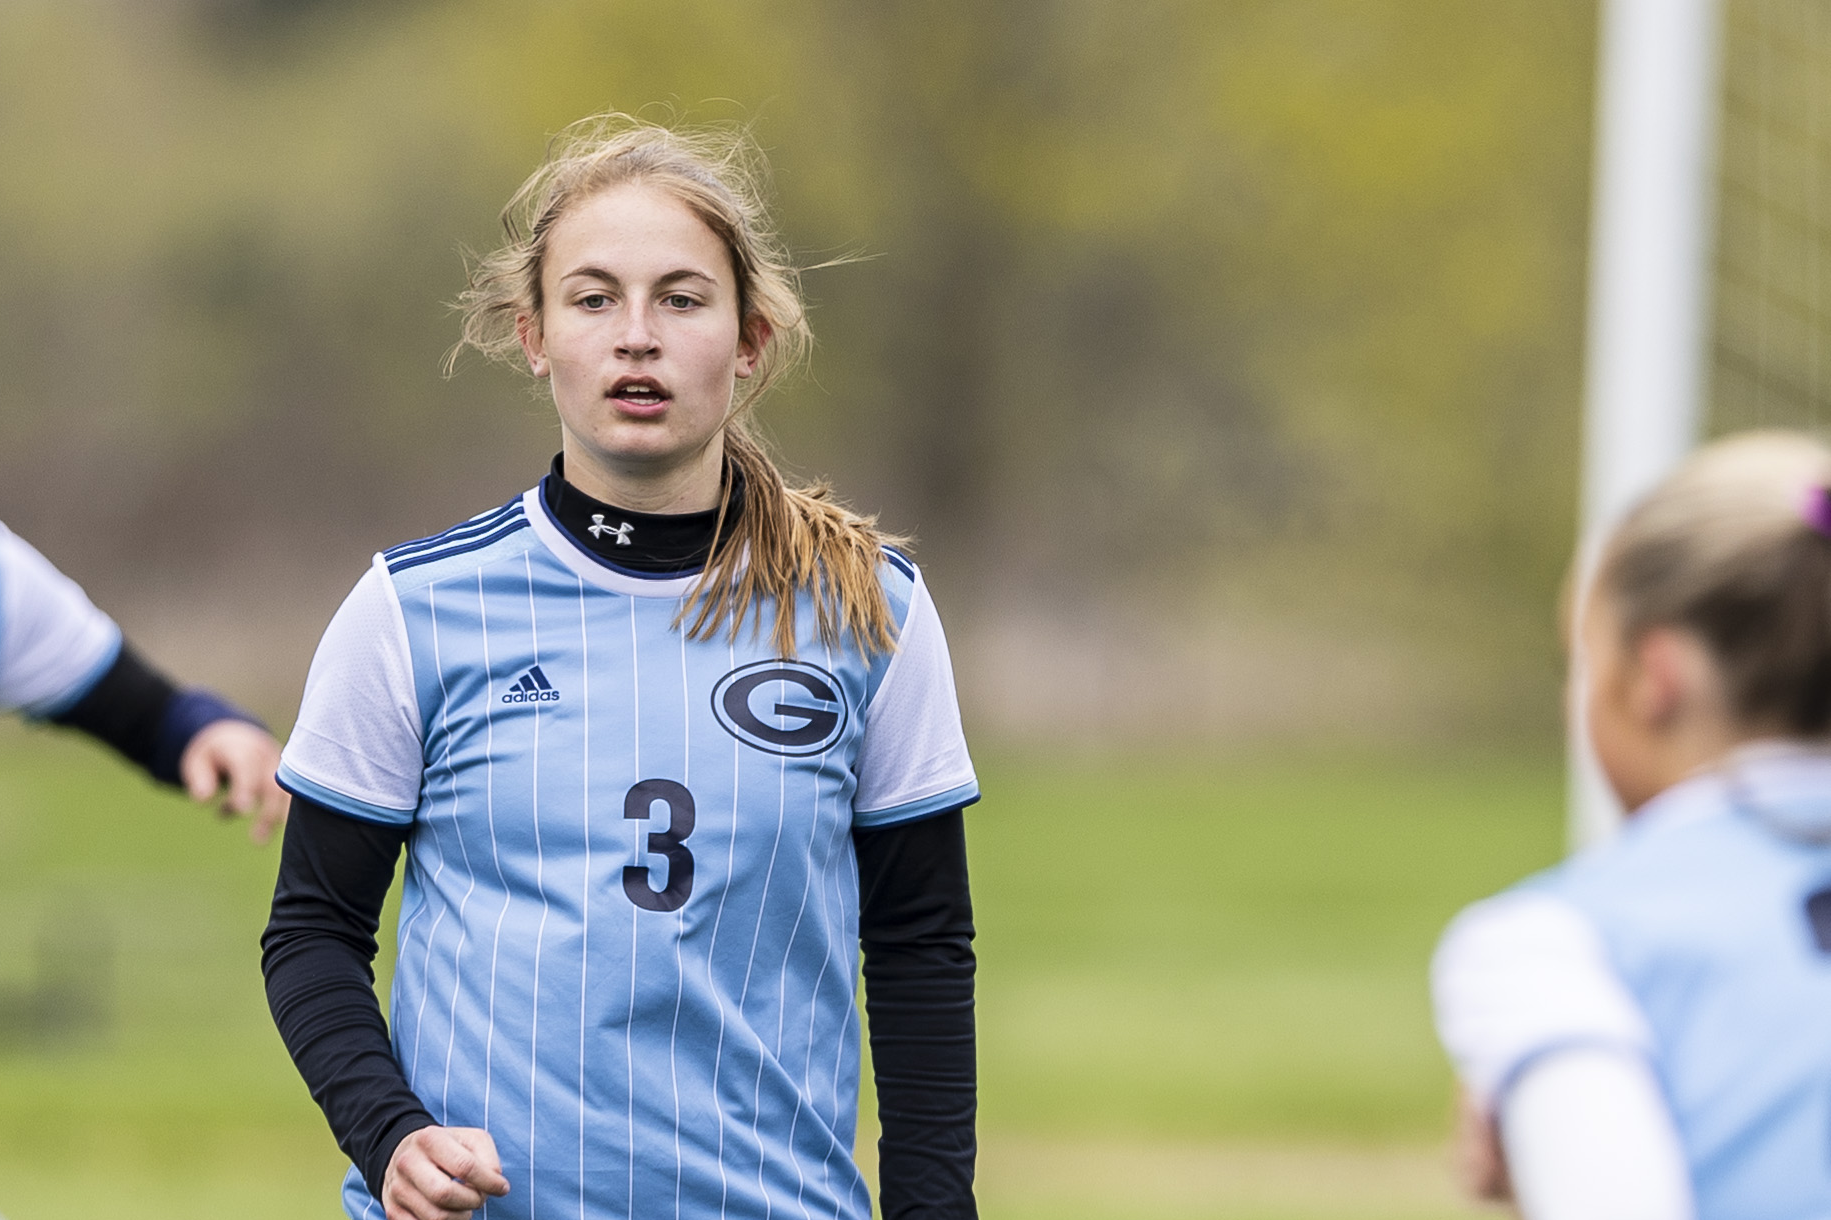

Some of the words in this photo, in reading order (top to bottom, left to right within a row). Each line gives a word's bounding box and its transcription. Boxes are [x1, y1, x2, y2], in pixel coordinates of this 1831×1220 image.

[501, 688, 560, 704] adidas
[722, 668, 839, 747] G
[622, 778, 696, 912] 3
